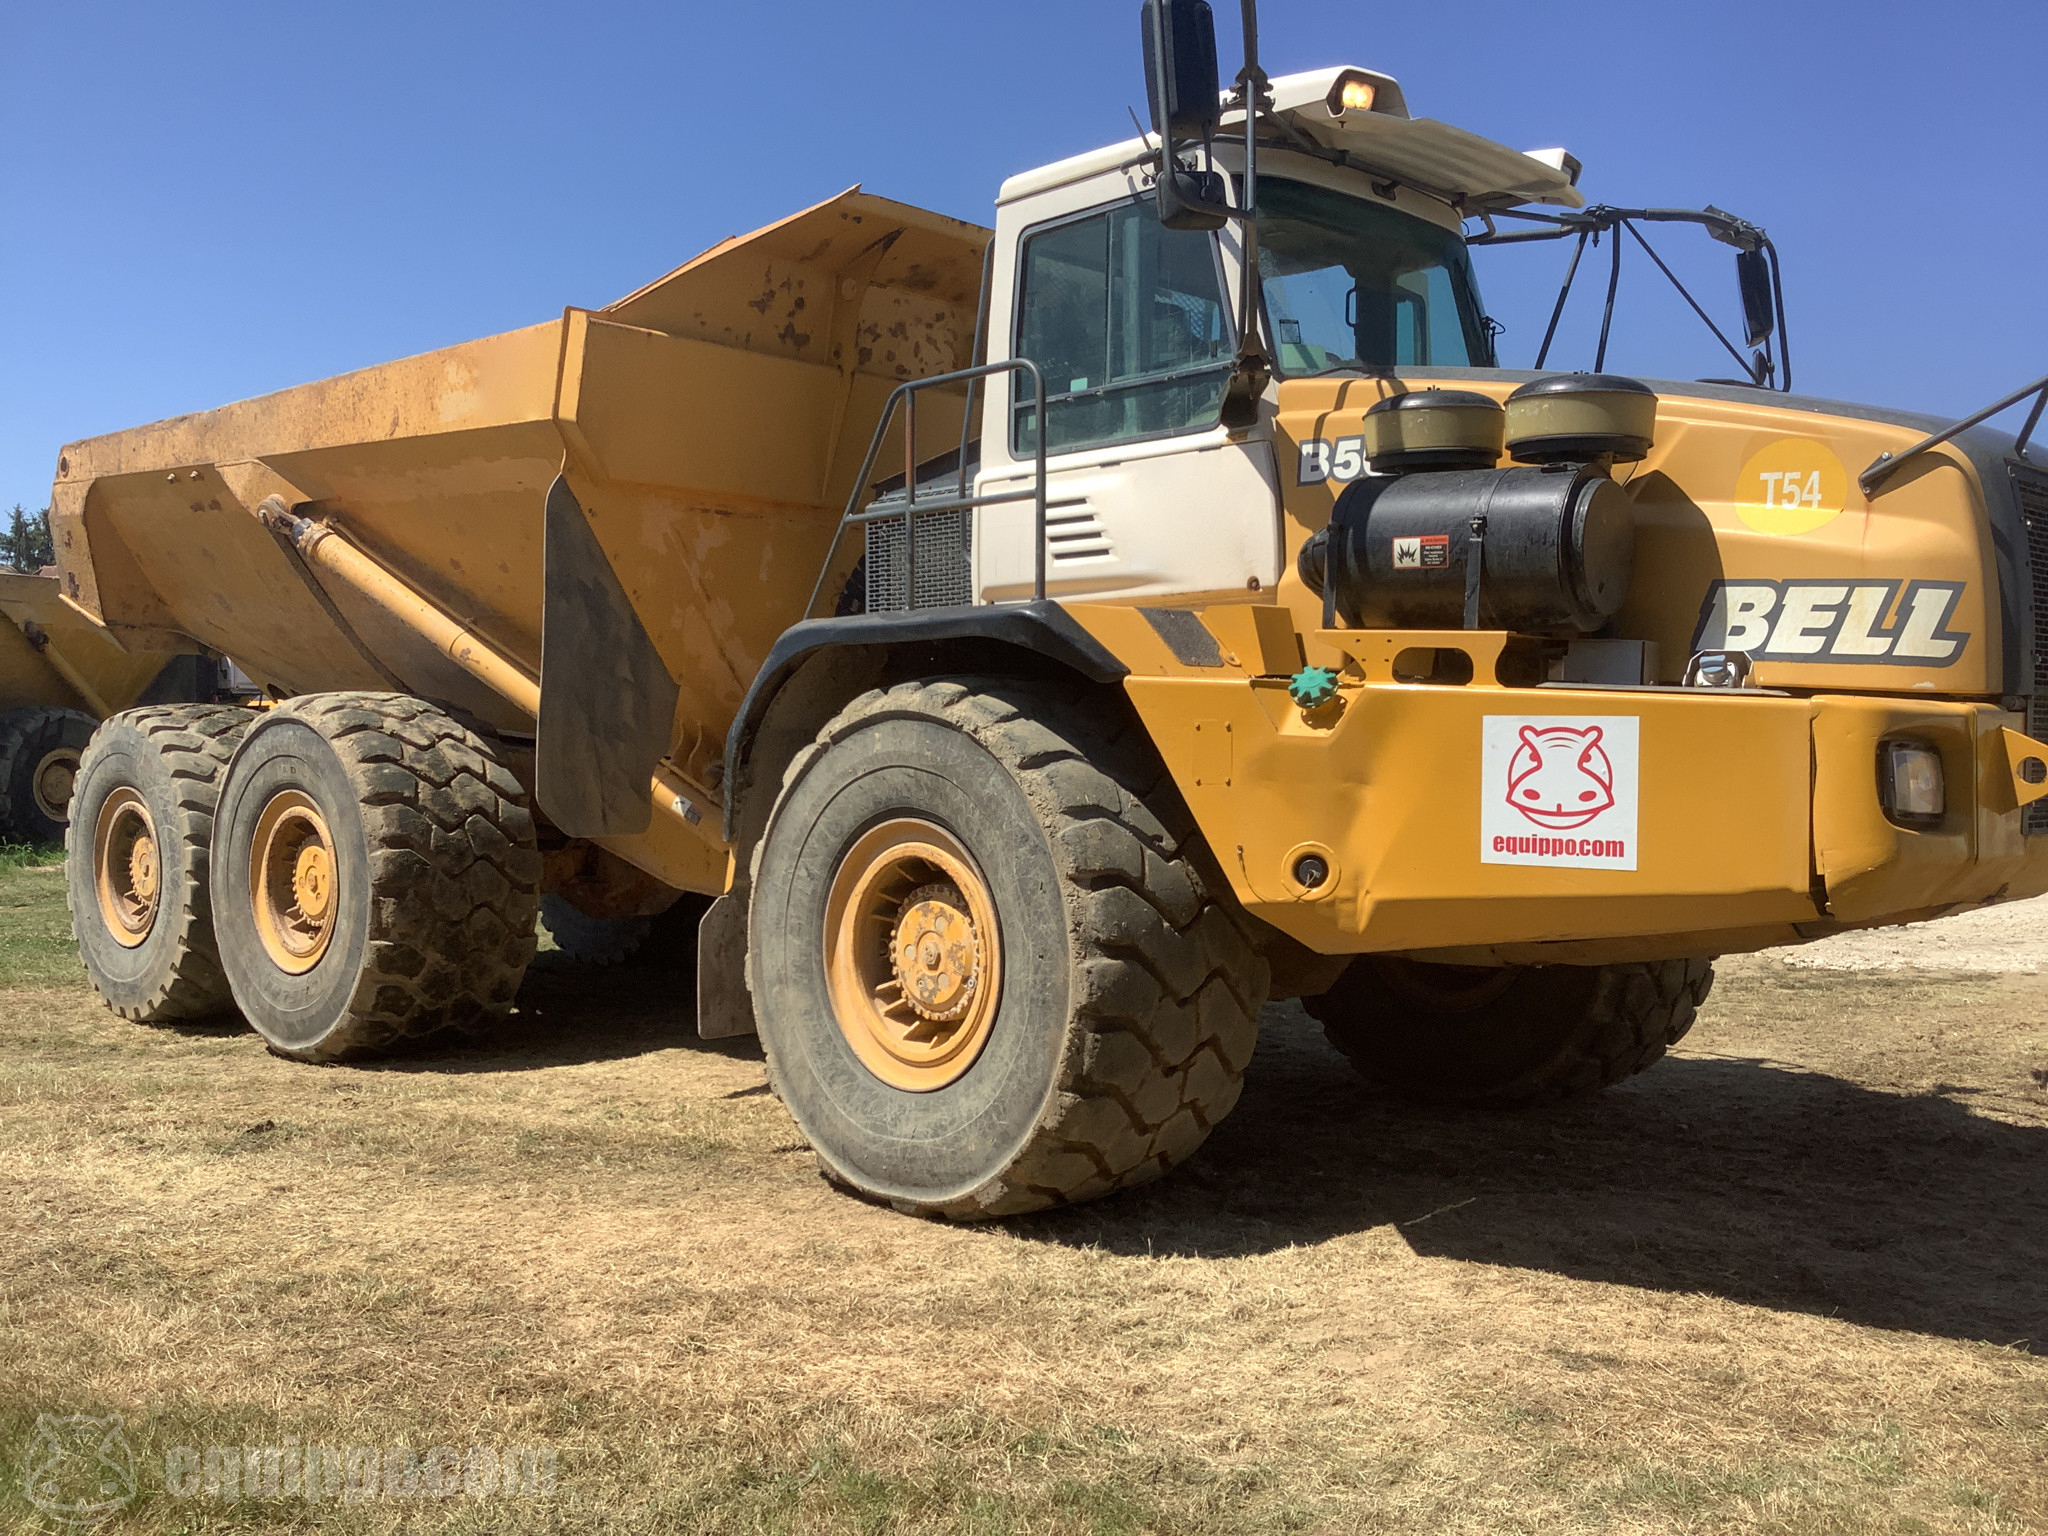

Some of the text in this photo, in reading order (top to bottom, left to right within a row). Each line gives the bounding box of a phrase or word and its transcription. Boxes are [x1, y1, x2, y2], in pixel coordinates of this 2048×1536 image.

[1299, 437, 1397, 483] B5
[1760, 470, 1822, 510] T54
[1695, 585, 1960, 660] BELL
[1492, 833, 1625, 858] equippo.com
